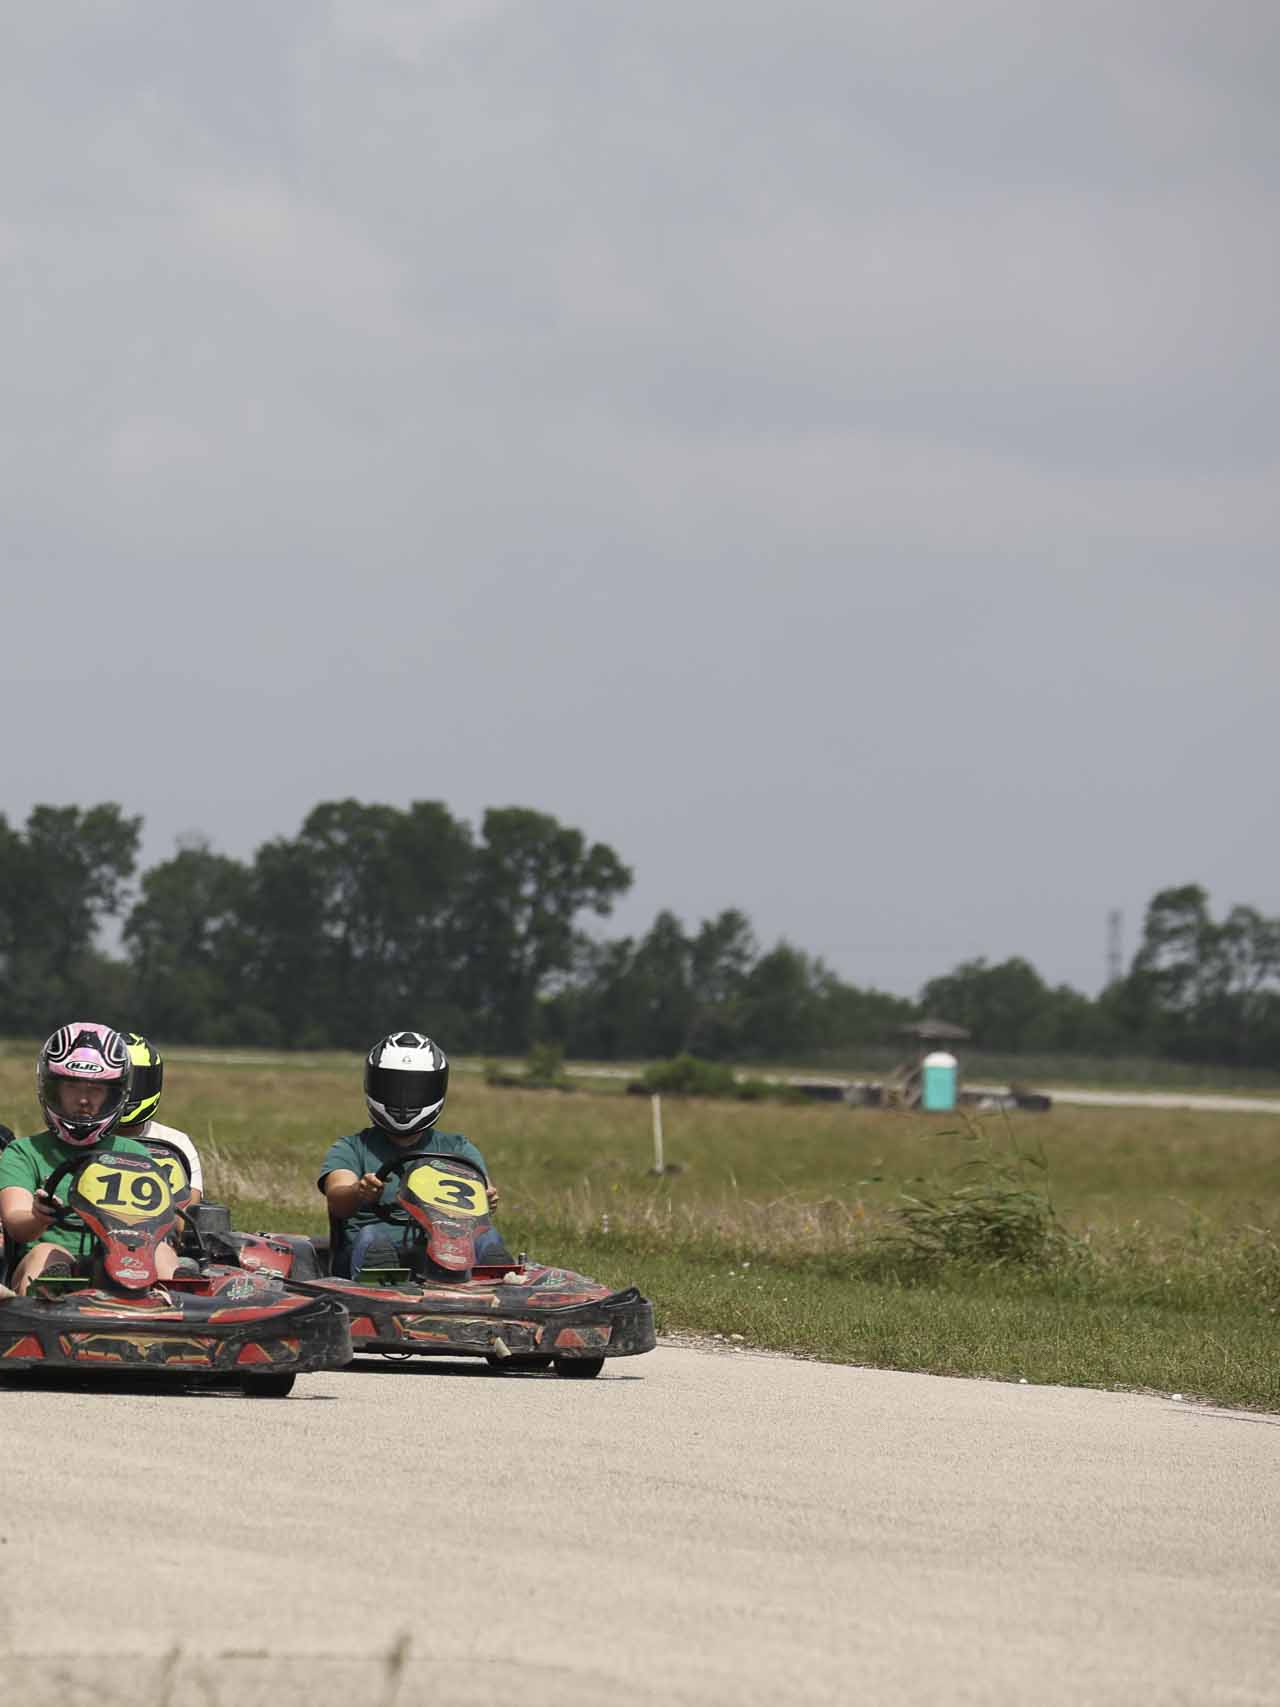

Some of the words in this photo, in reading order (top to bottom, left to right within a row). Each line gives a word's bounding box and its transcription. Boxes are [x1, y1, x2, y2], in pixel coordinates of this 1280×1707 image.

[69, 1062, 99, 1072] HJC
[95, 1172, 163, 1212] 19
[433, 1179, 476, 1211] 3
